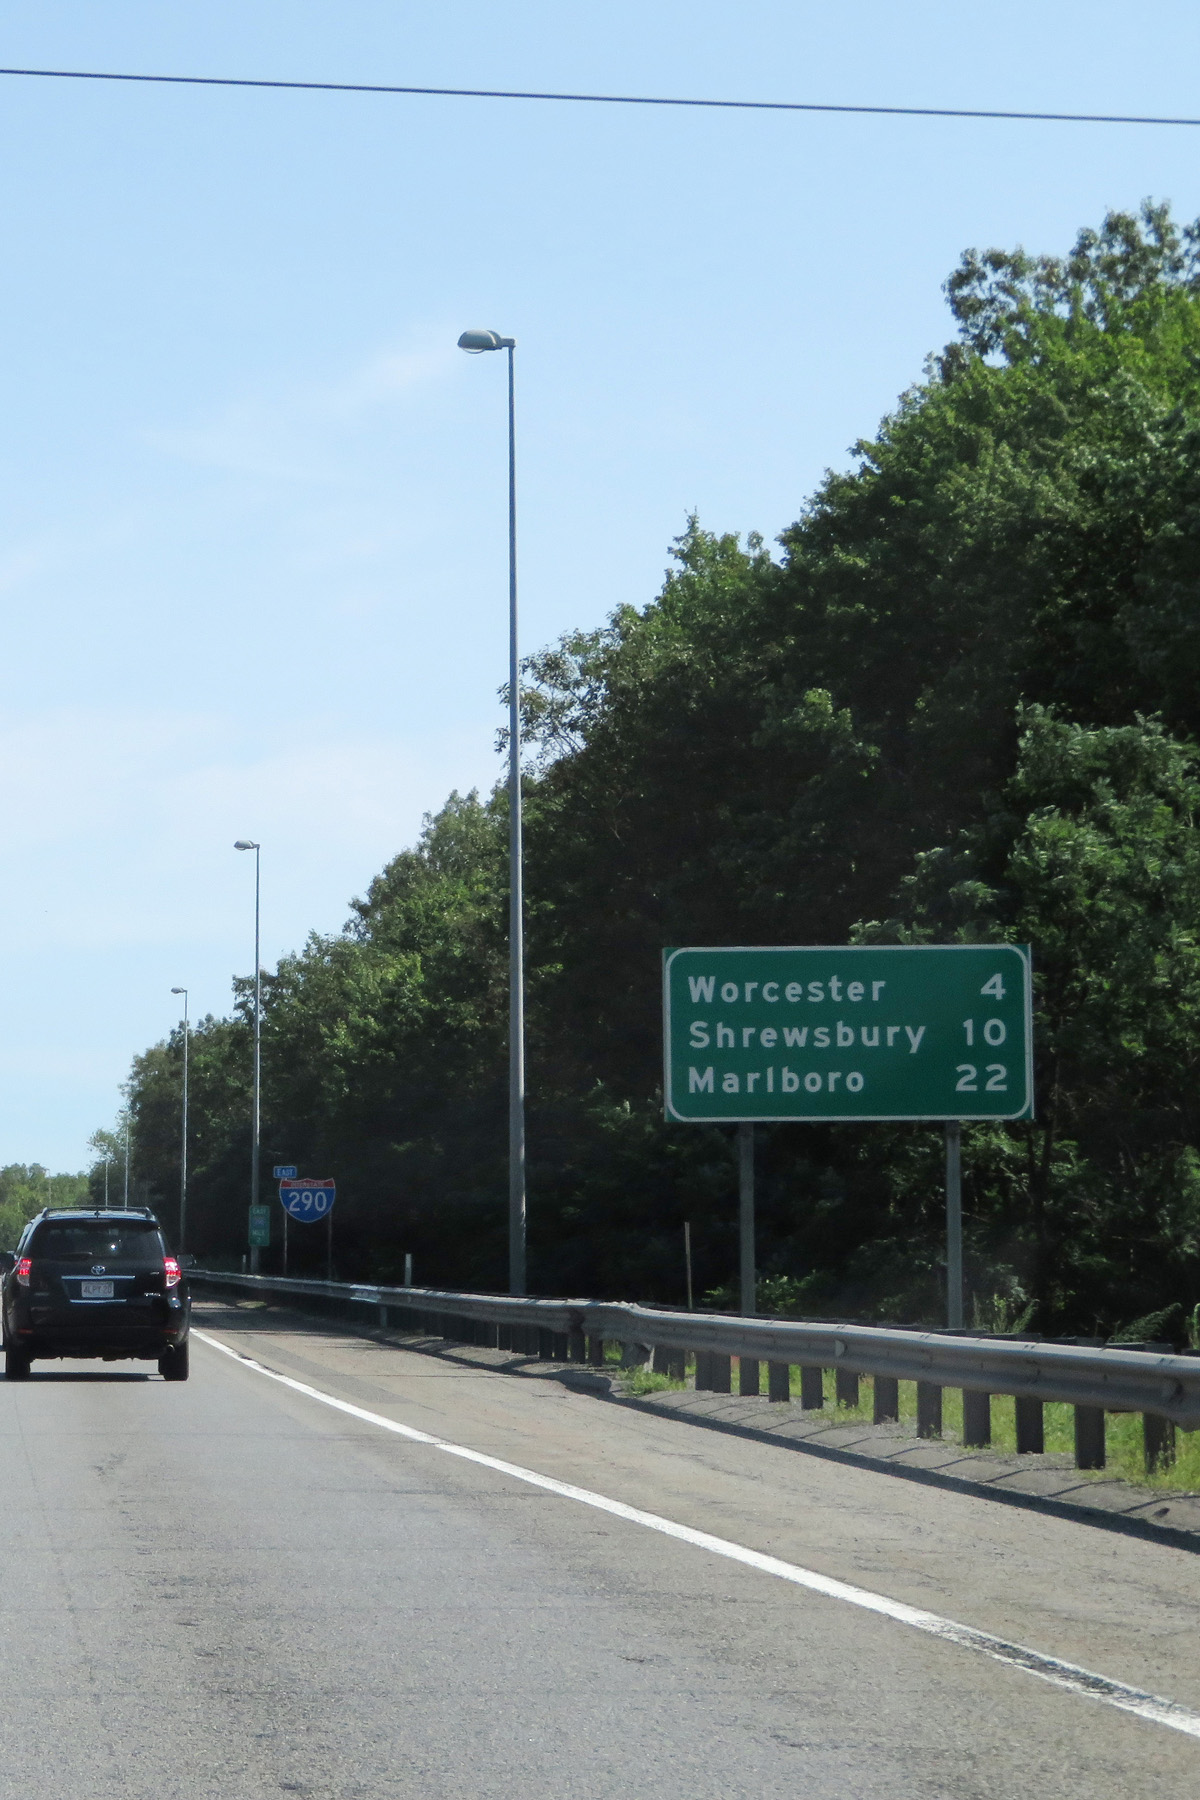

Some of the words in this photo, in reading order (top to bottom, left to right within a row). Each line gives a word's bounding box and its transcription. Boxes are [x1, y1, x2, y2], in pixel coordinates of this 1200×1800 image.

[687, 975, 886, 1003] Worcester
[980, 973, 1007, 1000] 4
[688, 1020, 927, 1054] Shrewsbury
[962, 1018, 1007, 1047] 10
[687, 1065, 866, 1094] Marlboro
[954, 1064, 1008, 1092] 22
[277, 1168, 293, 1176] EAST
[289, 1192, 327, 1211] 290
